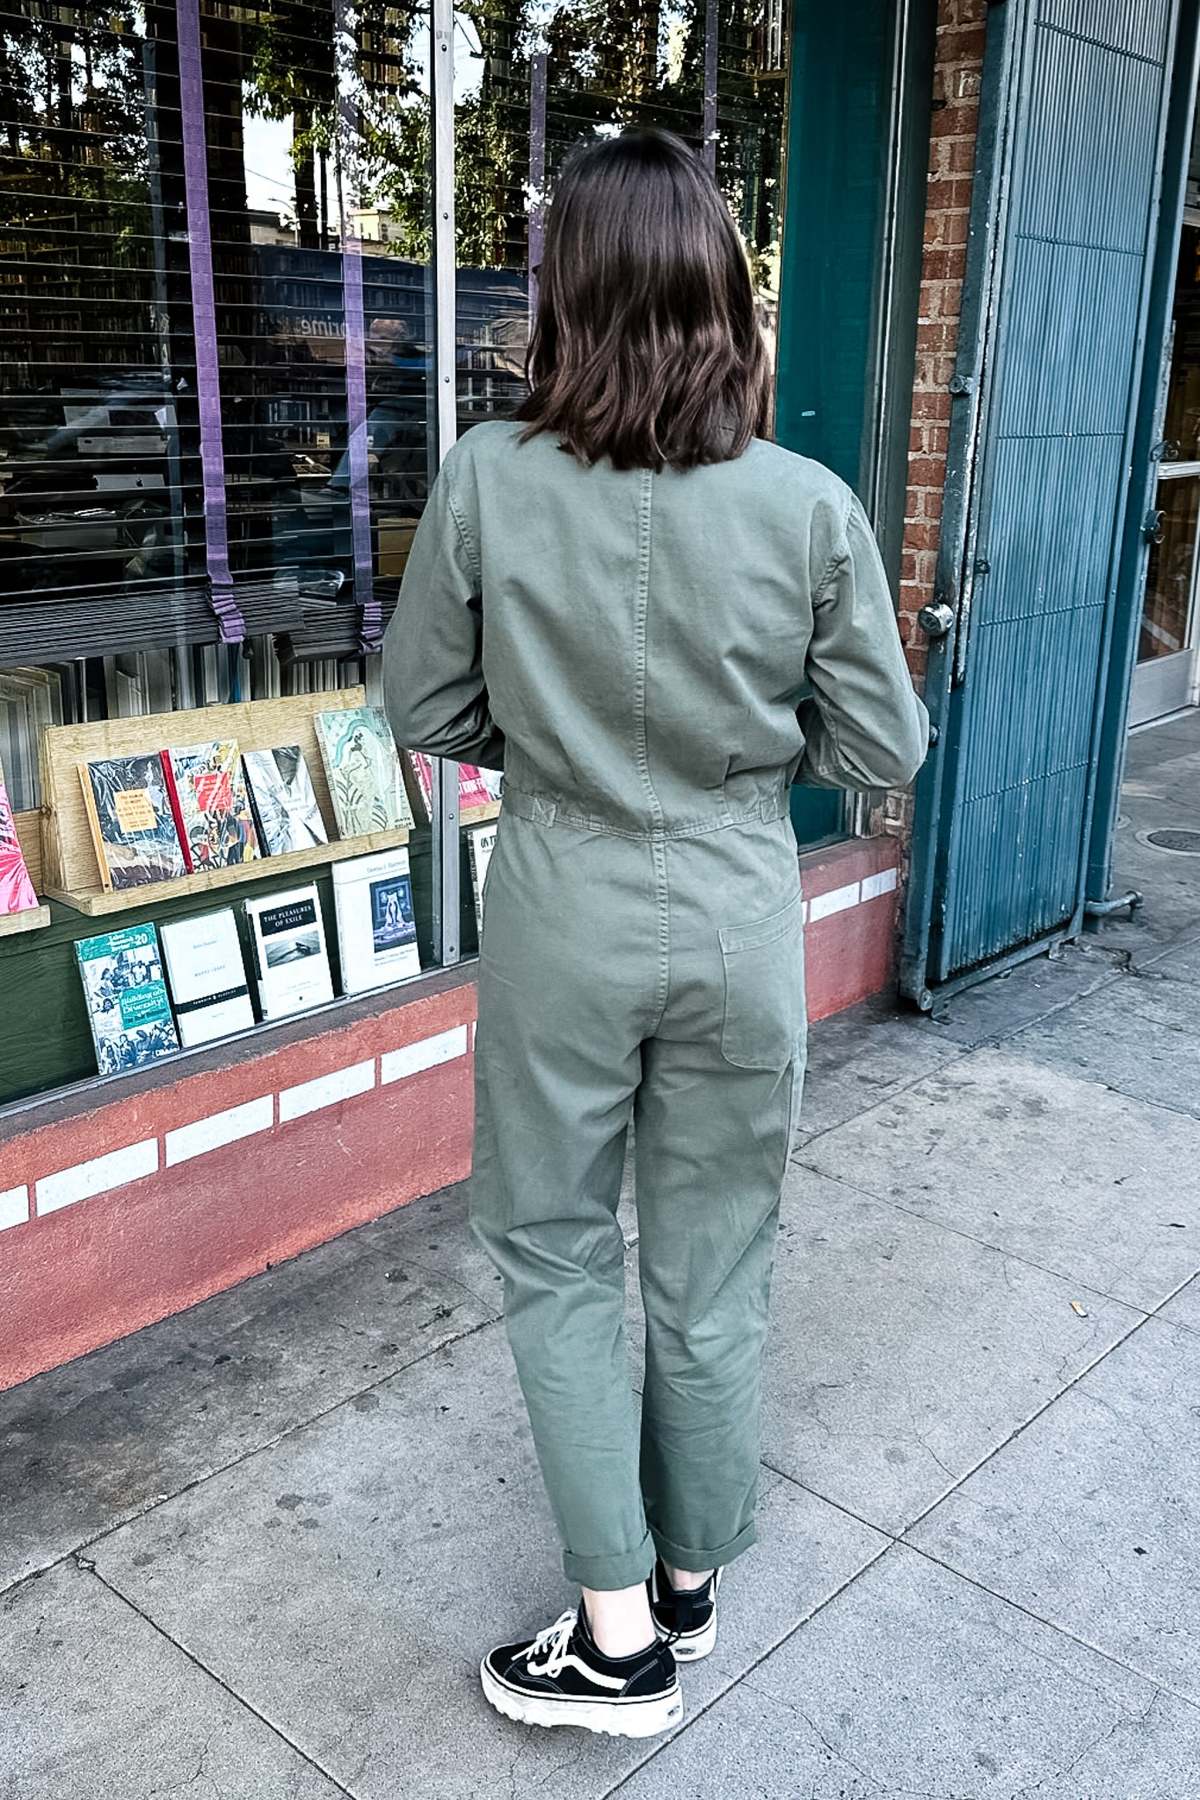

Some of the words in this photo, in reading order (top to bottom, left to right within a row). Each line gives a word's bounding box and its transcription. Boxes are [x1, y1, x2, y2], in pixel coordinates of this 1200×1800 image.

[263, 914, 277, 923] THE
[278, 905, 312, 918] PLEASURES
[275, 919, 284, 927] OF
[285, 914, 303, 924] EXILE
